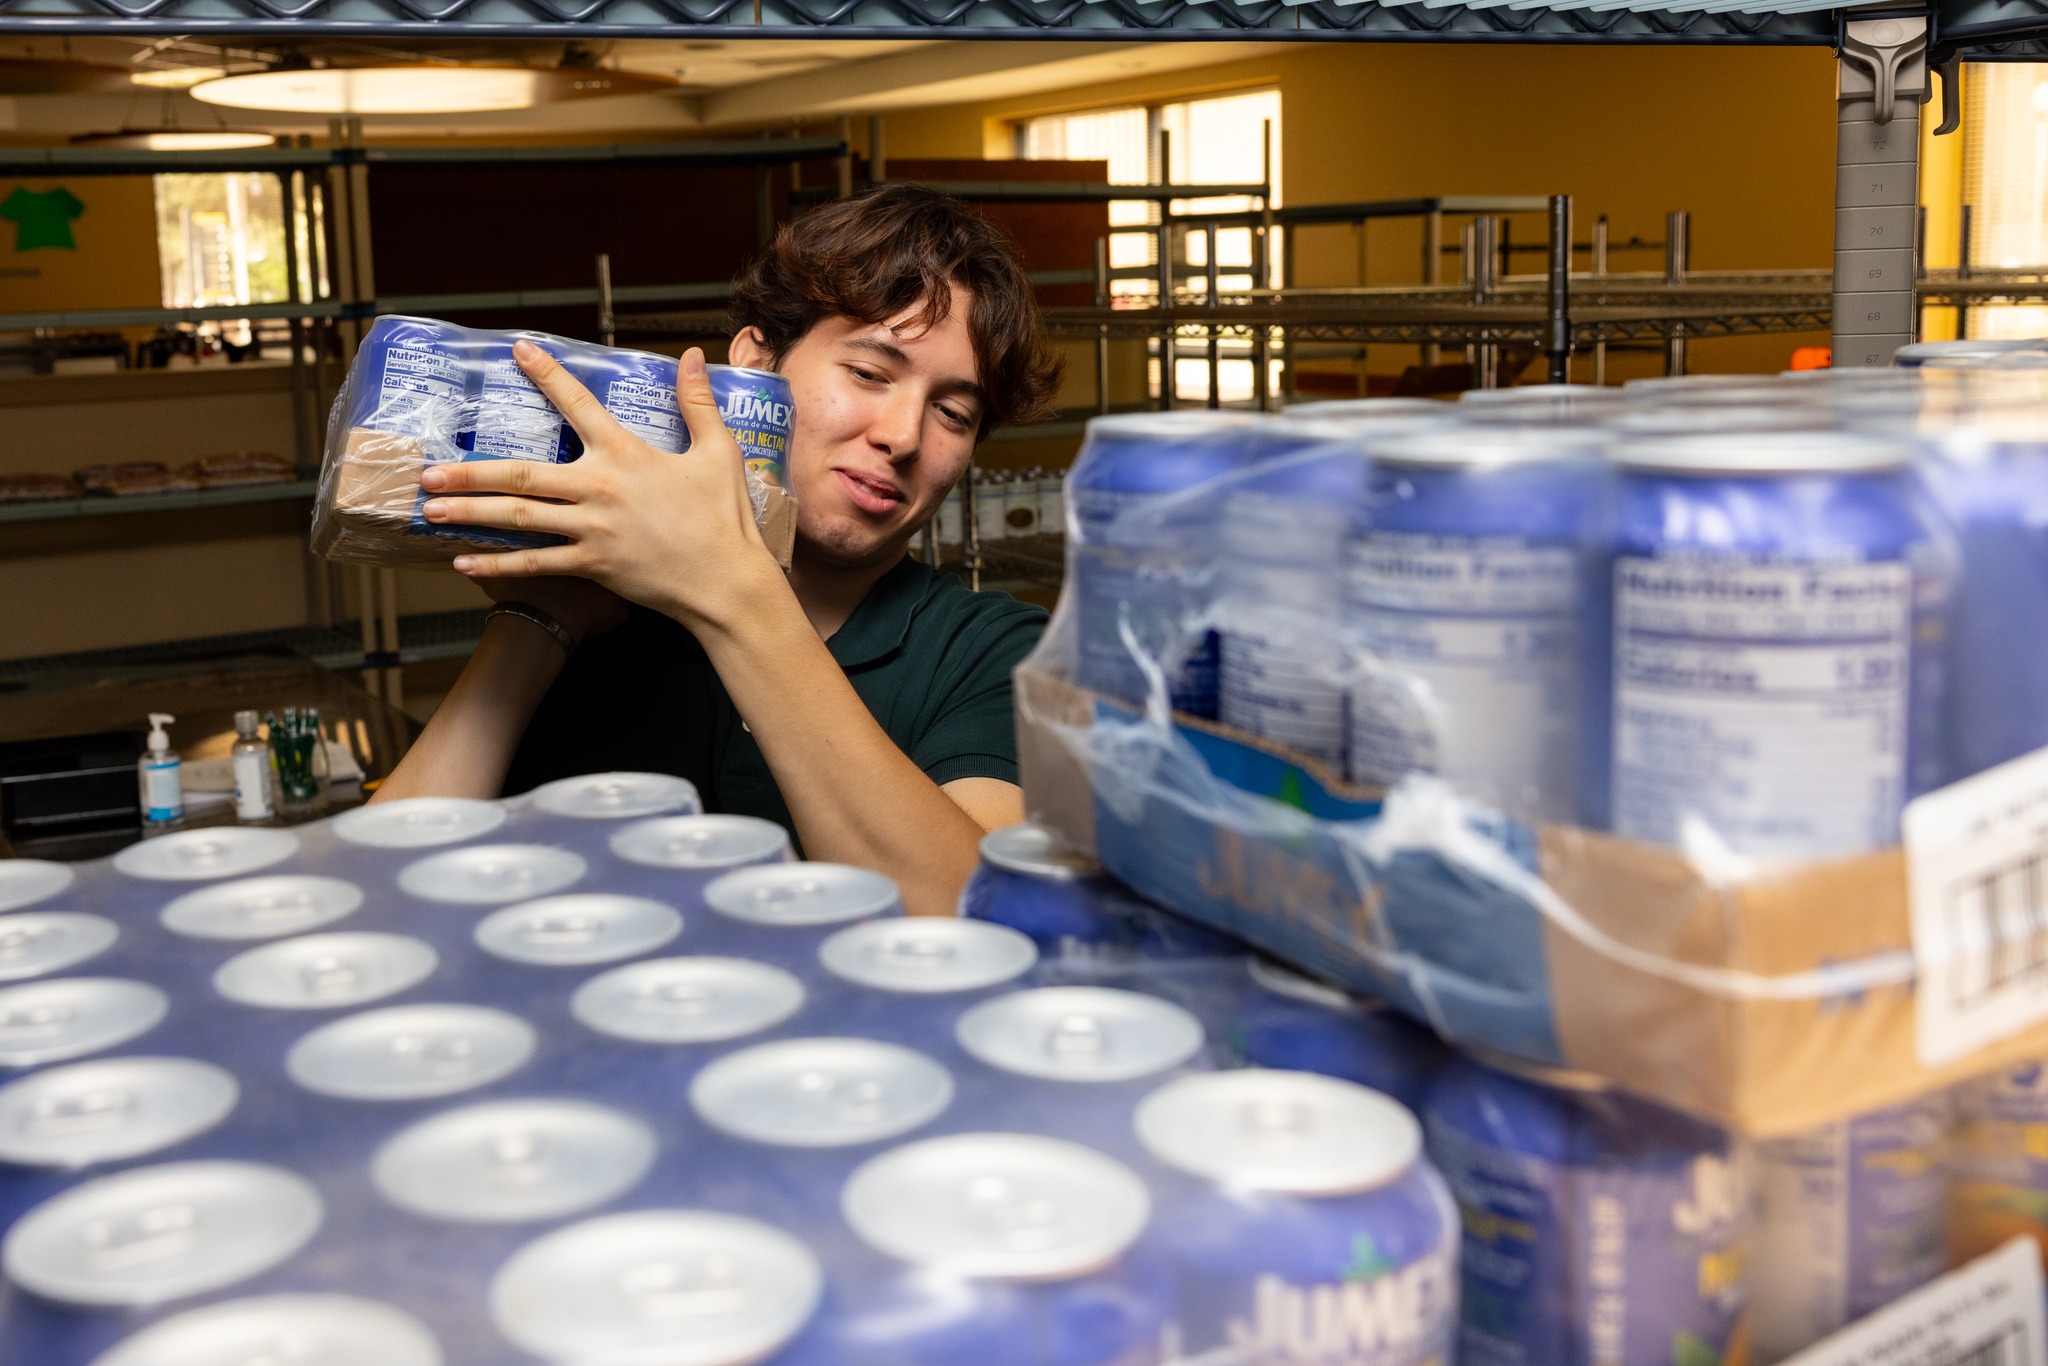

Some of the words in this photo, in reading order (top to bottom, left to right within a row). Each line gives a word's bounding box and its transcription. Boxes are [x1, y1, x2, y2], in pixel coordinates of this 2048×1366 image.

[1873, 141, 1886, 150] 72
[1871, 184, 1883, 193] 71
[1870, 226, 1884, 236] 70
[1868, 269, 1882, 279] 69
[1867, 312, 1881, 321] 68
[388, 349, 440, 366] Nutrition
[443, 359, 467, 375] Facts
[1866, 354, 1880, 363] 67
[386, 361, 412, 369] Serving
[433, 368, 446, 376] Can
[486, 366, 527, 378] Nutritio
[611, 383, 661, 398] Nutrition
[609, 394, 632, 402] Serving
[718, 391, 795, 430] JUMEX
[608, 410, 650, 423] Calories
[728, 418, 749, 427] Fruta
[751, 421, 760, 429] de
[488, 441, 524, 449] Carbohydrate
[758, 431, 785, 453] NECTAR
[749, 445, 778, 458] CONCENTRATE
[1221, 1258, 1454, 1362] JUME
